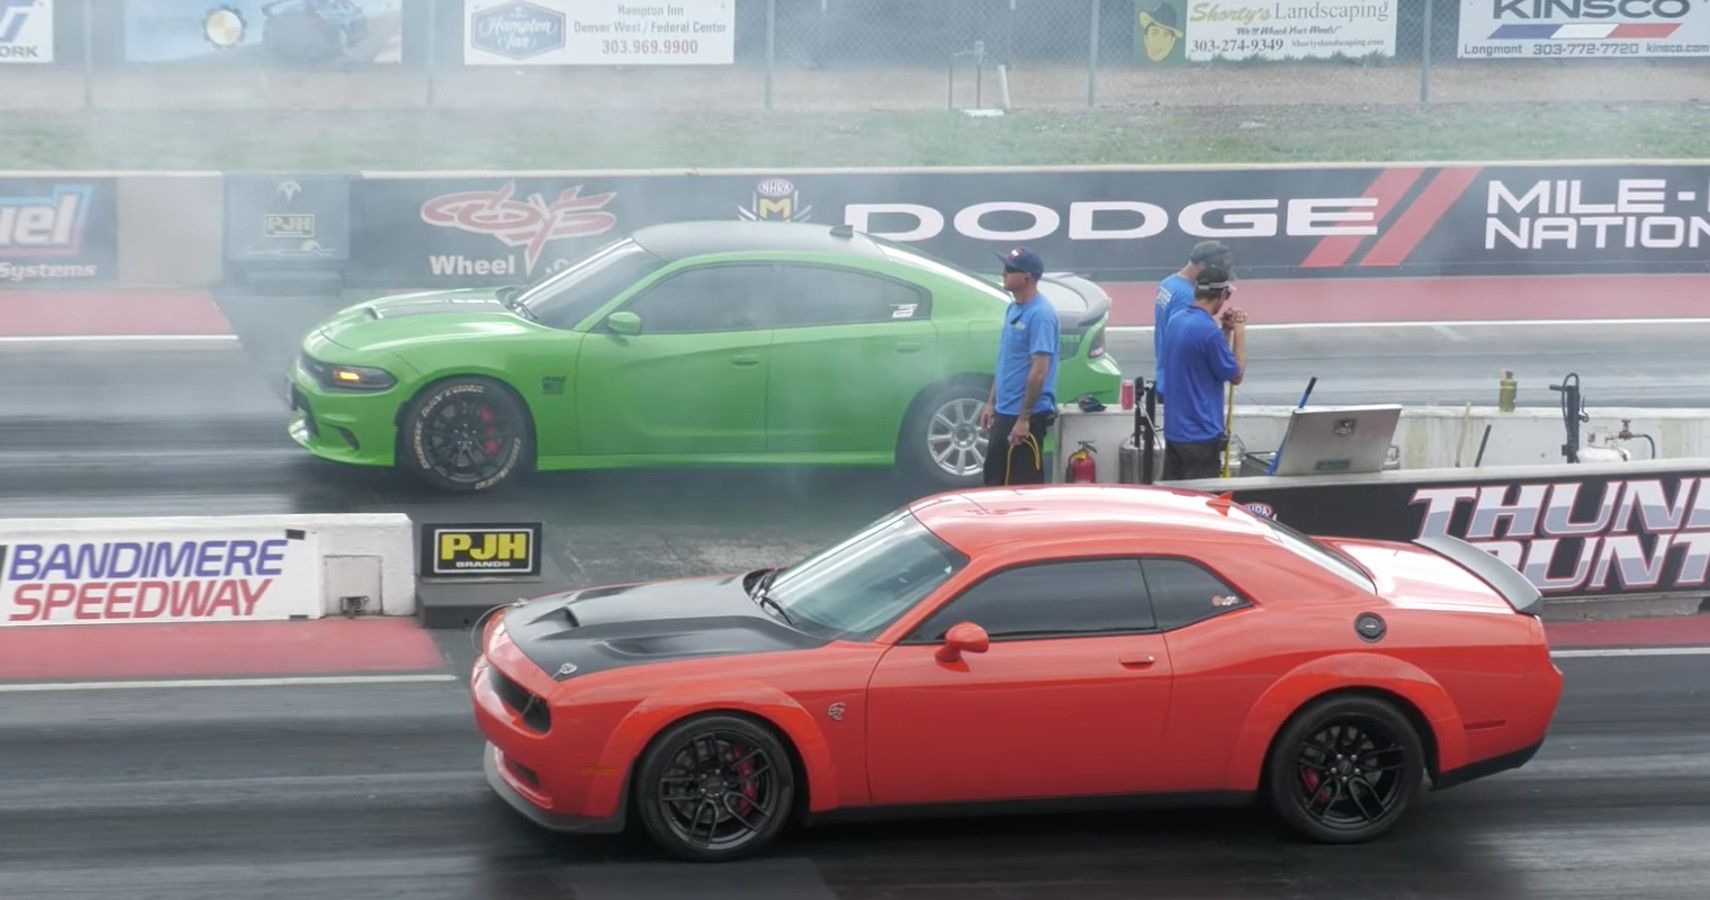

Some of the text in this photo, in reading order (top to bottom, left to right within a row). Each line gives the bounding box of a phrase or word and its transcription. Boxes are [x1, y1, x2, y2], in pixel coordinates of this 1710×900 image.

[618, 5, 684, 16] Hampton Inn
[1275, 1, 1389, 22] Landscaping
[1493, 0, 1690, 19] KINSCO
[574, 21, 610, 33] Denver
[613, 21, 641, 33] West
[650, 21, 689, 33] Federal
[692, 21, 727, 33] Center
[602, 40, 699, 55] 303.969.9900
[1191, 39, 1284, 53] 303-274-9349
[1464, 42, 1710, 55] Longmont 303-772-7720 kinsco.com
[845, 197, 1379, 242] DODGE
[0, 262, 98, 281] Systems
[429, 255, 516, 275] Wheel
[441, 533, 527, 560] PJH
[8, 539, 289, 581] BANDIMERE
[9, 578, 273, 622] SPEEDWAY
